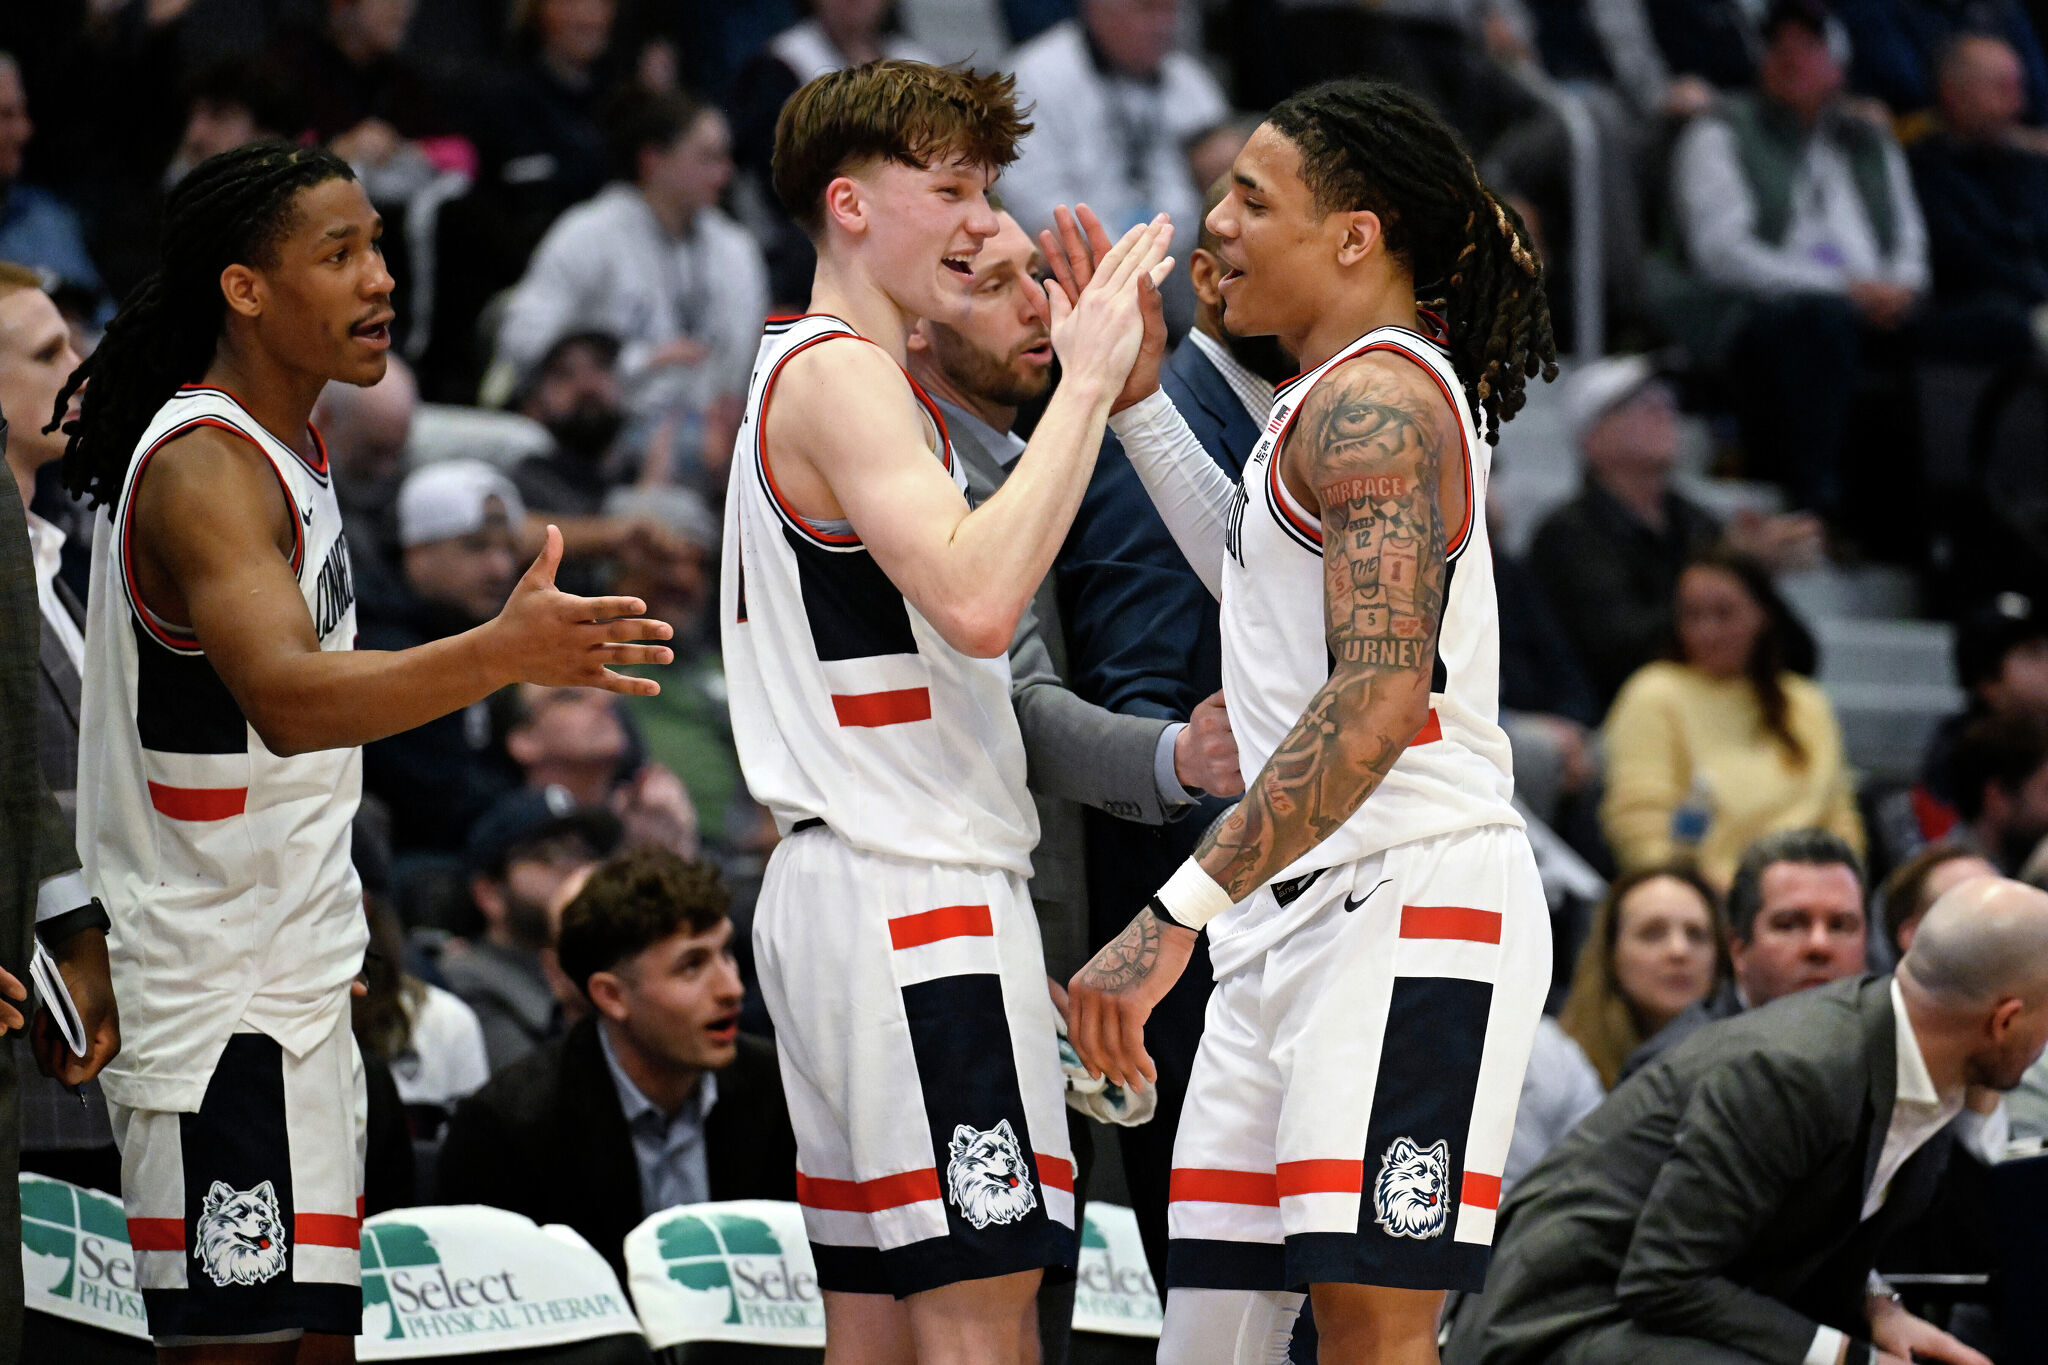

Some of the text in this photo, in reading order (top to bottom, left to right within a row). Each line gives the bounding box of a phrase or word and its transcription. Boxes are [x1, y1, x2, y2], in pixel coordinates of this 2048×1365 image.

[1356, 530, 1371, 549] 12
[1350, 556, 1380, 577] THE
[1367, 612, 1377, 627] 5
[79, 1236, 142, 1293] Se
[391, 1267, 522, 1314] Select
[404, 1293, 621, 1340] PHYSICAL THERAPY
